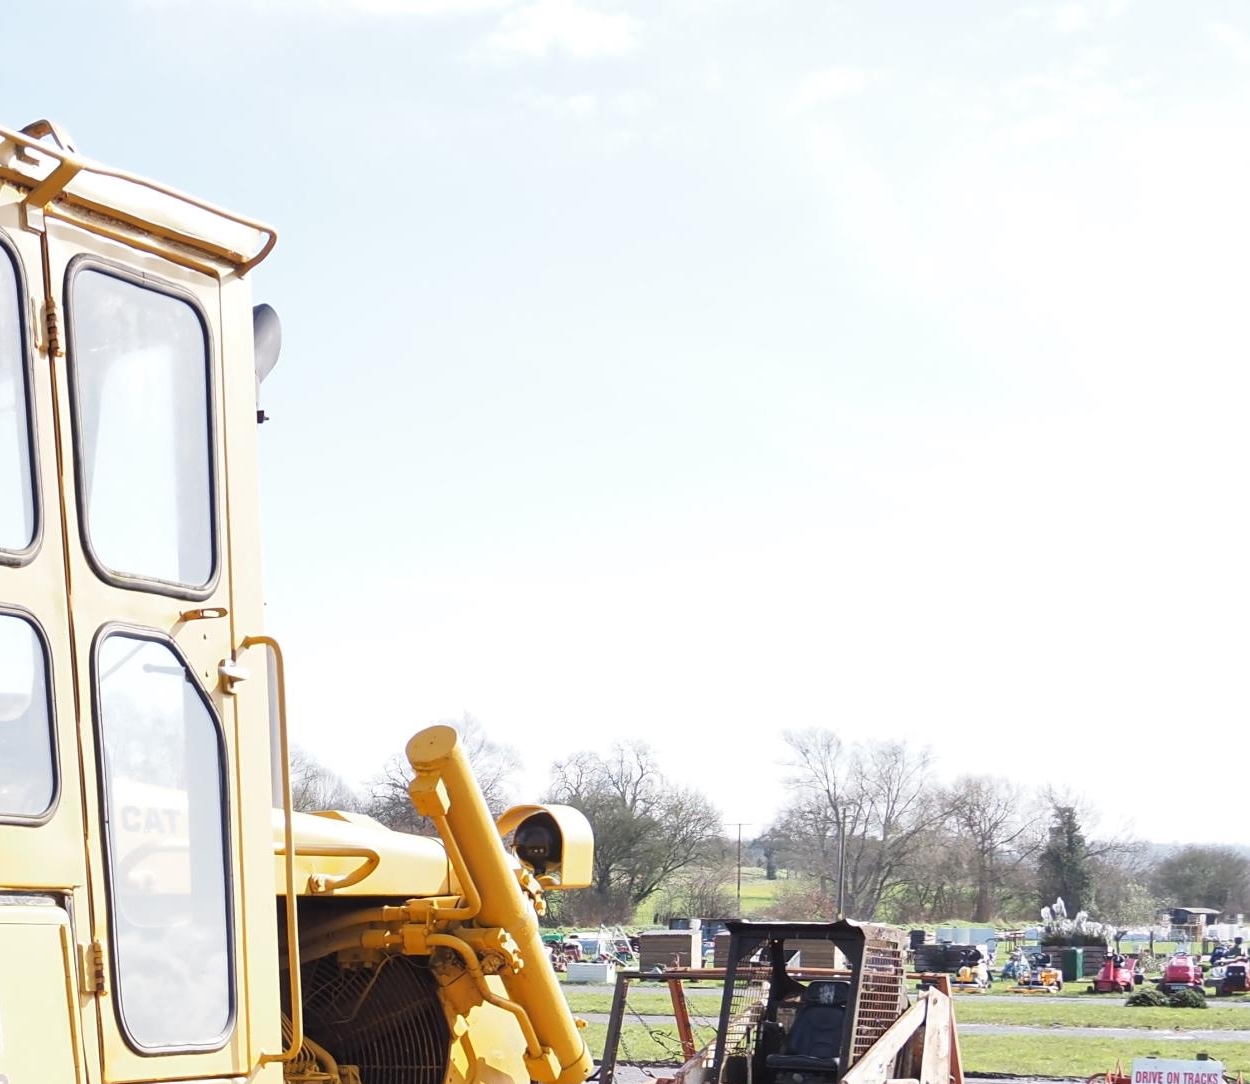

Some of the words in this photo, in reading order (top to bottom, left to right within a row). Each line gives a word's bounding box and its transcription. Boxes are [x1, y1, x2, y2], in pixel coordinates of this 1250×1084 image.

[121, 805, 181, 834] CAT
[1135, 1071, 1163, 1084] DRIVE
[1166, 1072, 1181, 1084] ON
